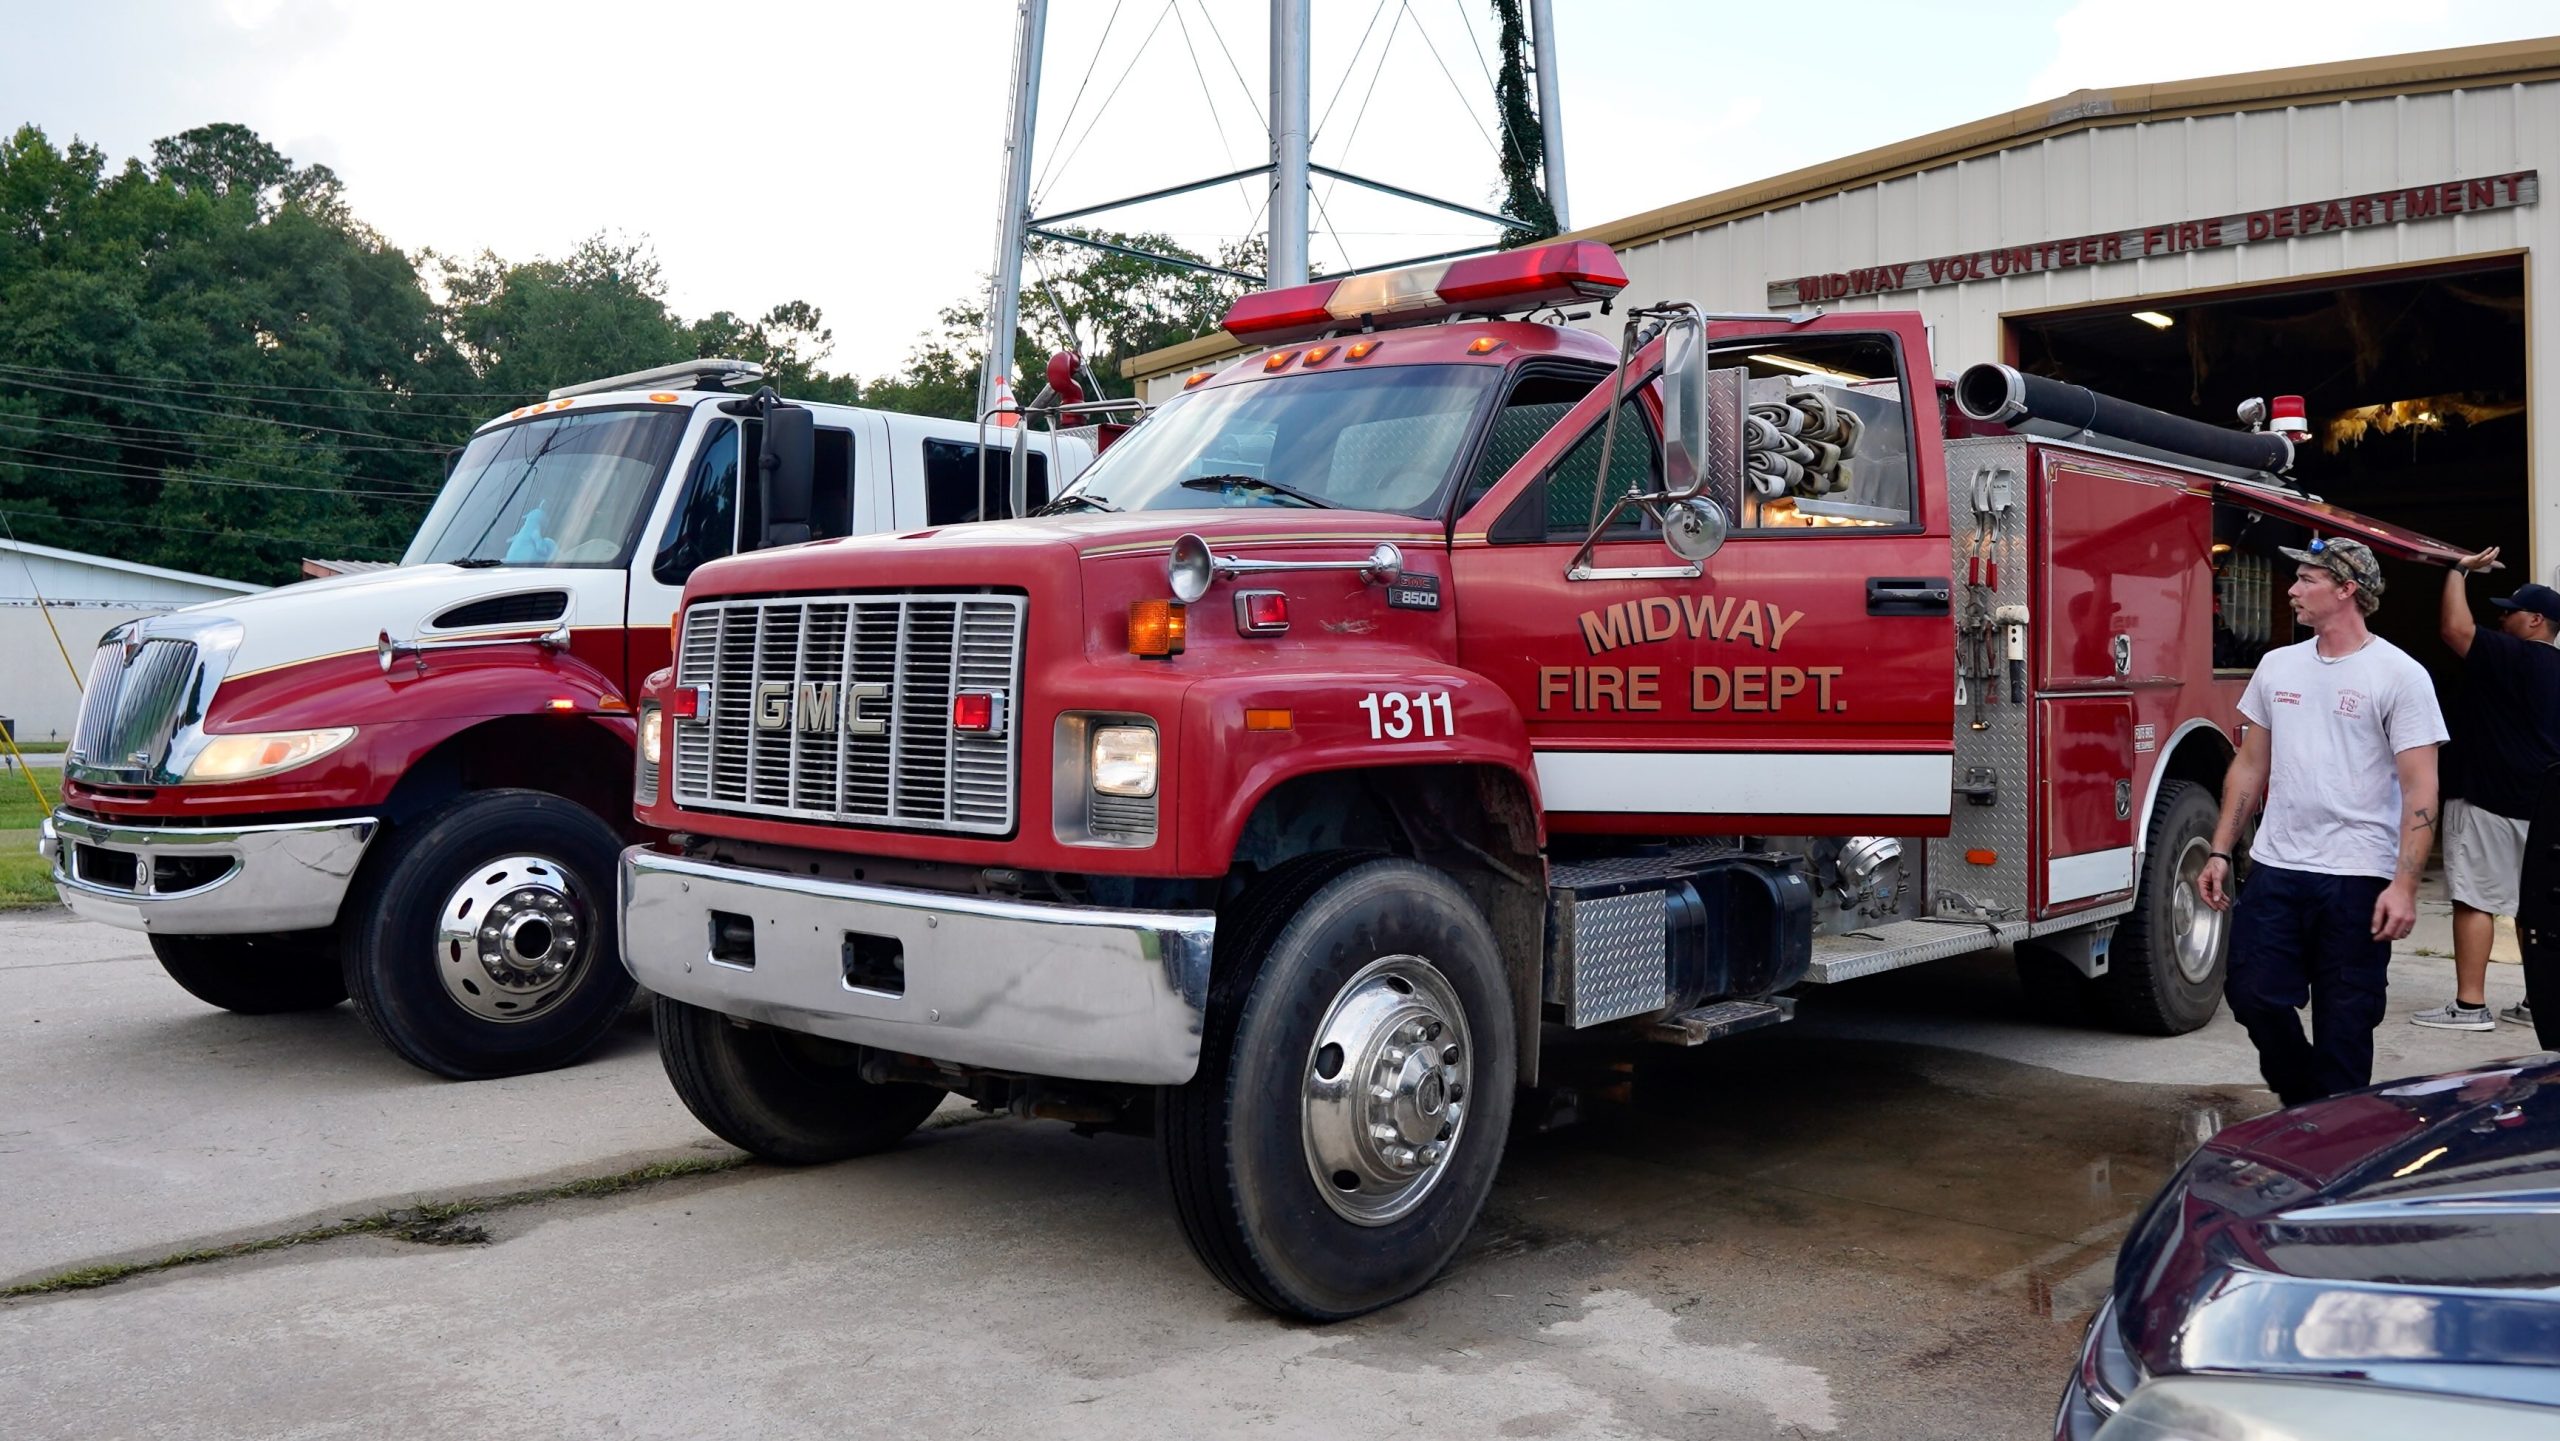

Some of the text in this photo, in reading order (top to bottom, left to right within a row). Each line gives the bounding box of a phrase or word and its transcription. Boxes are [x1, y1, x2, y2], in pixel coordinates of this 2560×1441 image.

[1798, 174, 2524, 301] MIDWAY VOLUNTEER FIRE DEPARTMENT
[1400, 577, 1431, 589] GMC
[1578, 594, 1805, 655] MIDWAY
[756, 681, 889, 734] GMC
[1538, 666, 1848, 713] FIRE DEPT.
[1358, 692, 1455, 739] 1311
